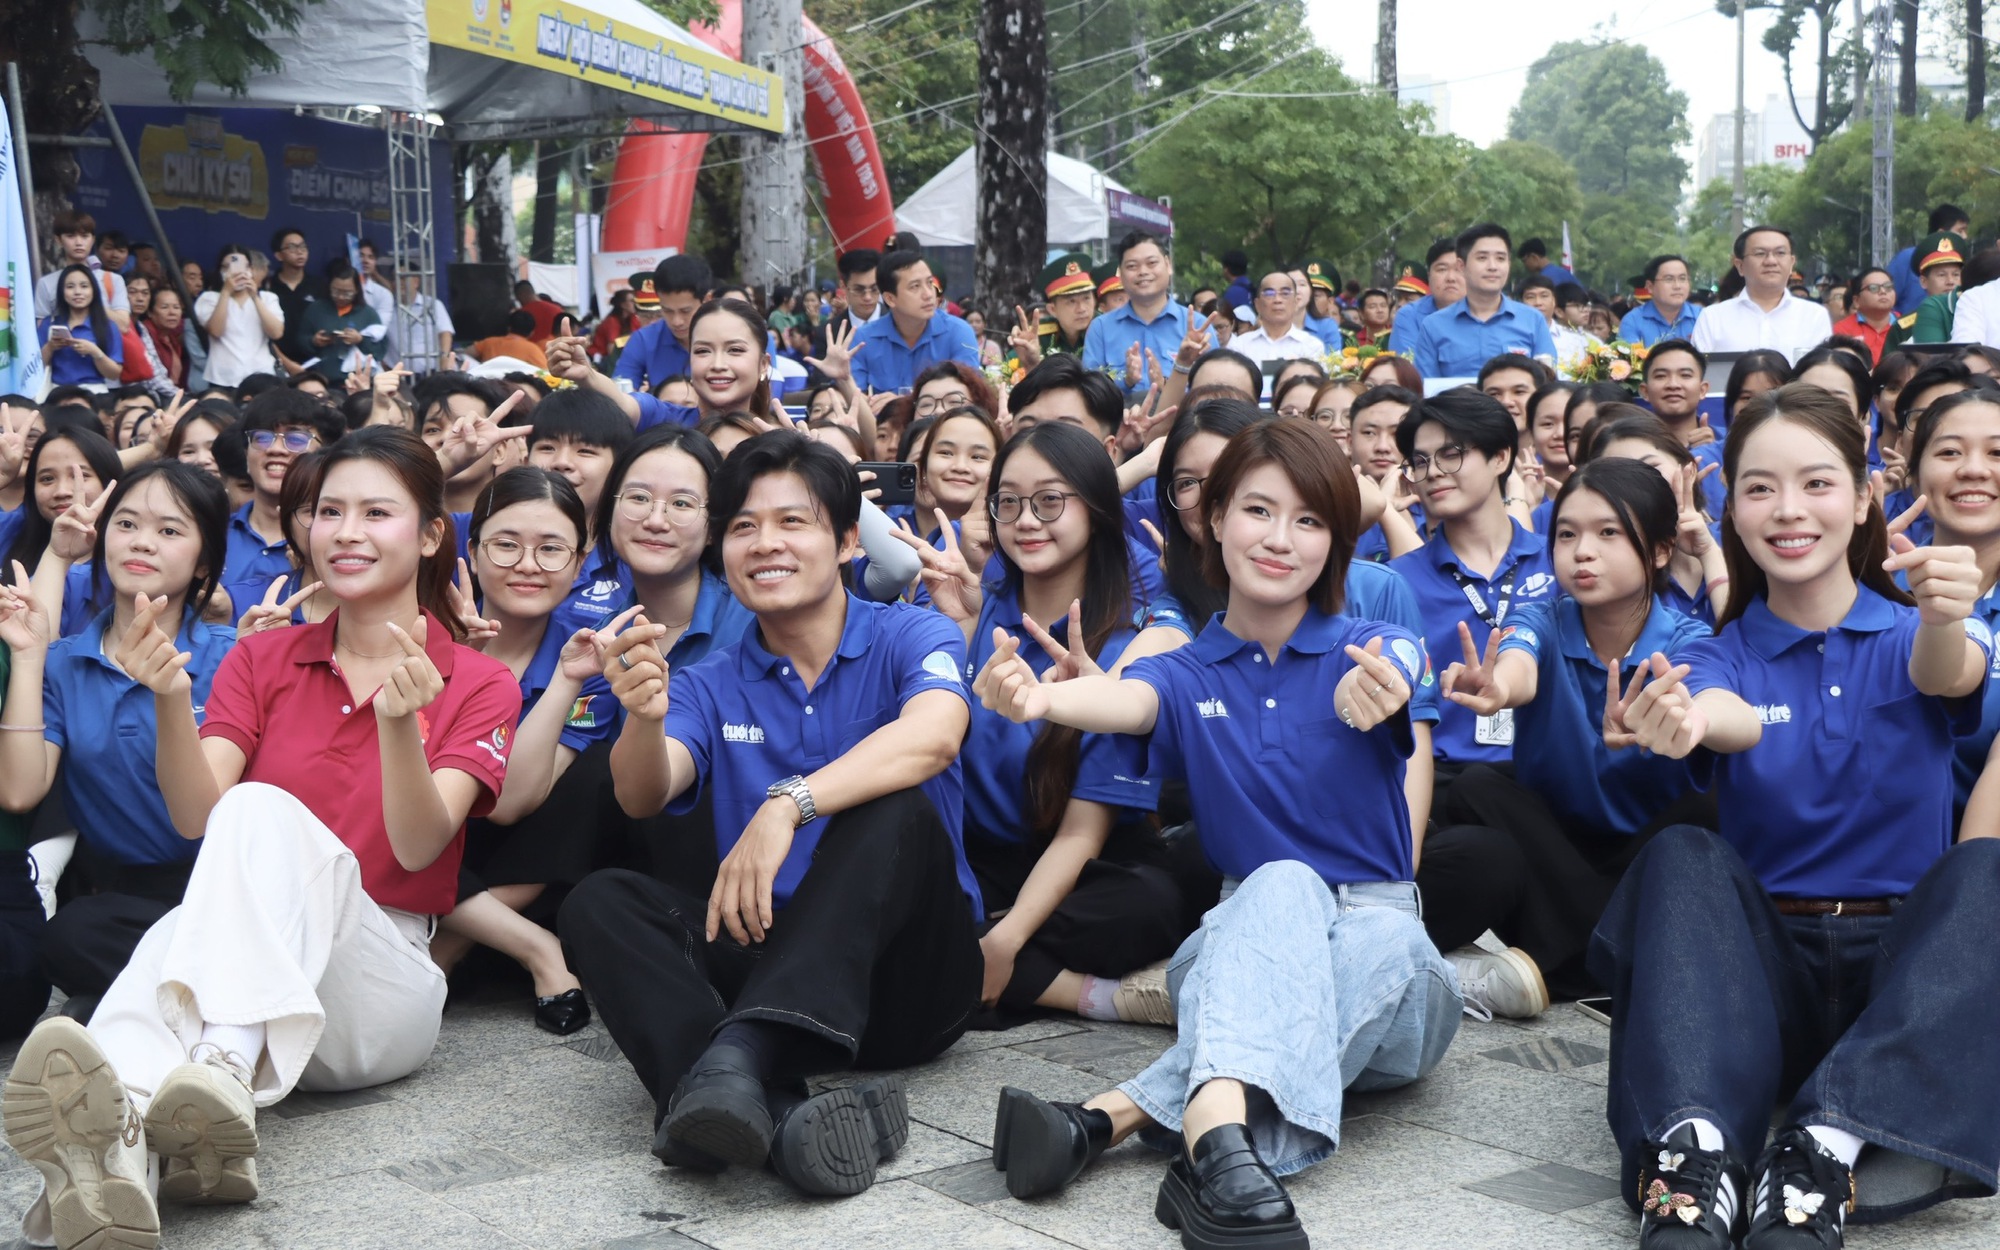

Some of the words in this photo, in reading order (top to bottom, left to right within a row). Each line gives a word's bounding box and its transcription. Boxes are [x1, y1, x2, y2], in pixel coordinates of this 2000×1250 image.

[537, 10, 571, 60] NGÀY
[571, 19, 591, 74] HỘI
[661, 49, 682, 94] NĂM
[164, 150, 199, 193] CHỮ
[203, 154, 228, 197] KÝ
[228, 152, 252, 199] SỐ
[1465, 586, 1485, 612] KAWS
